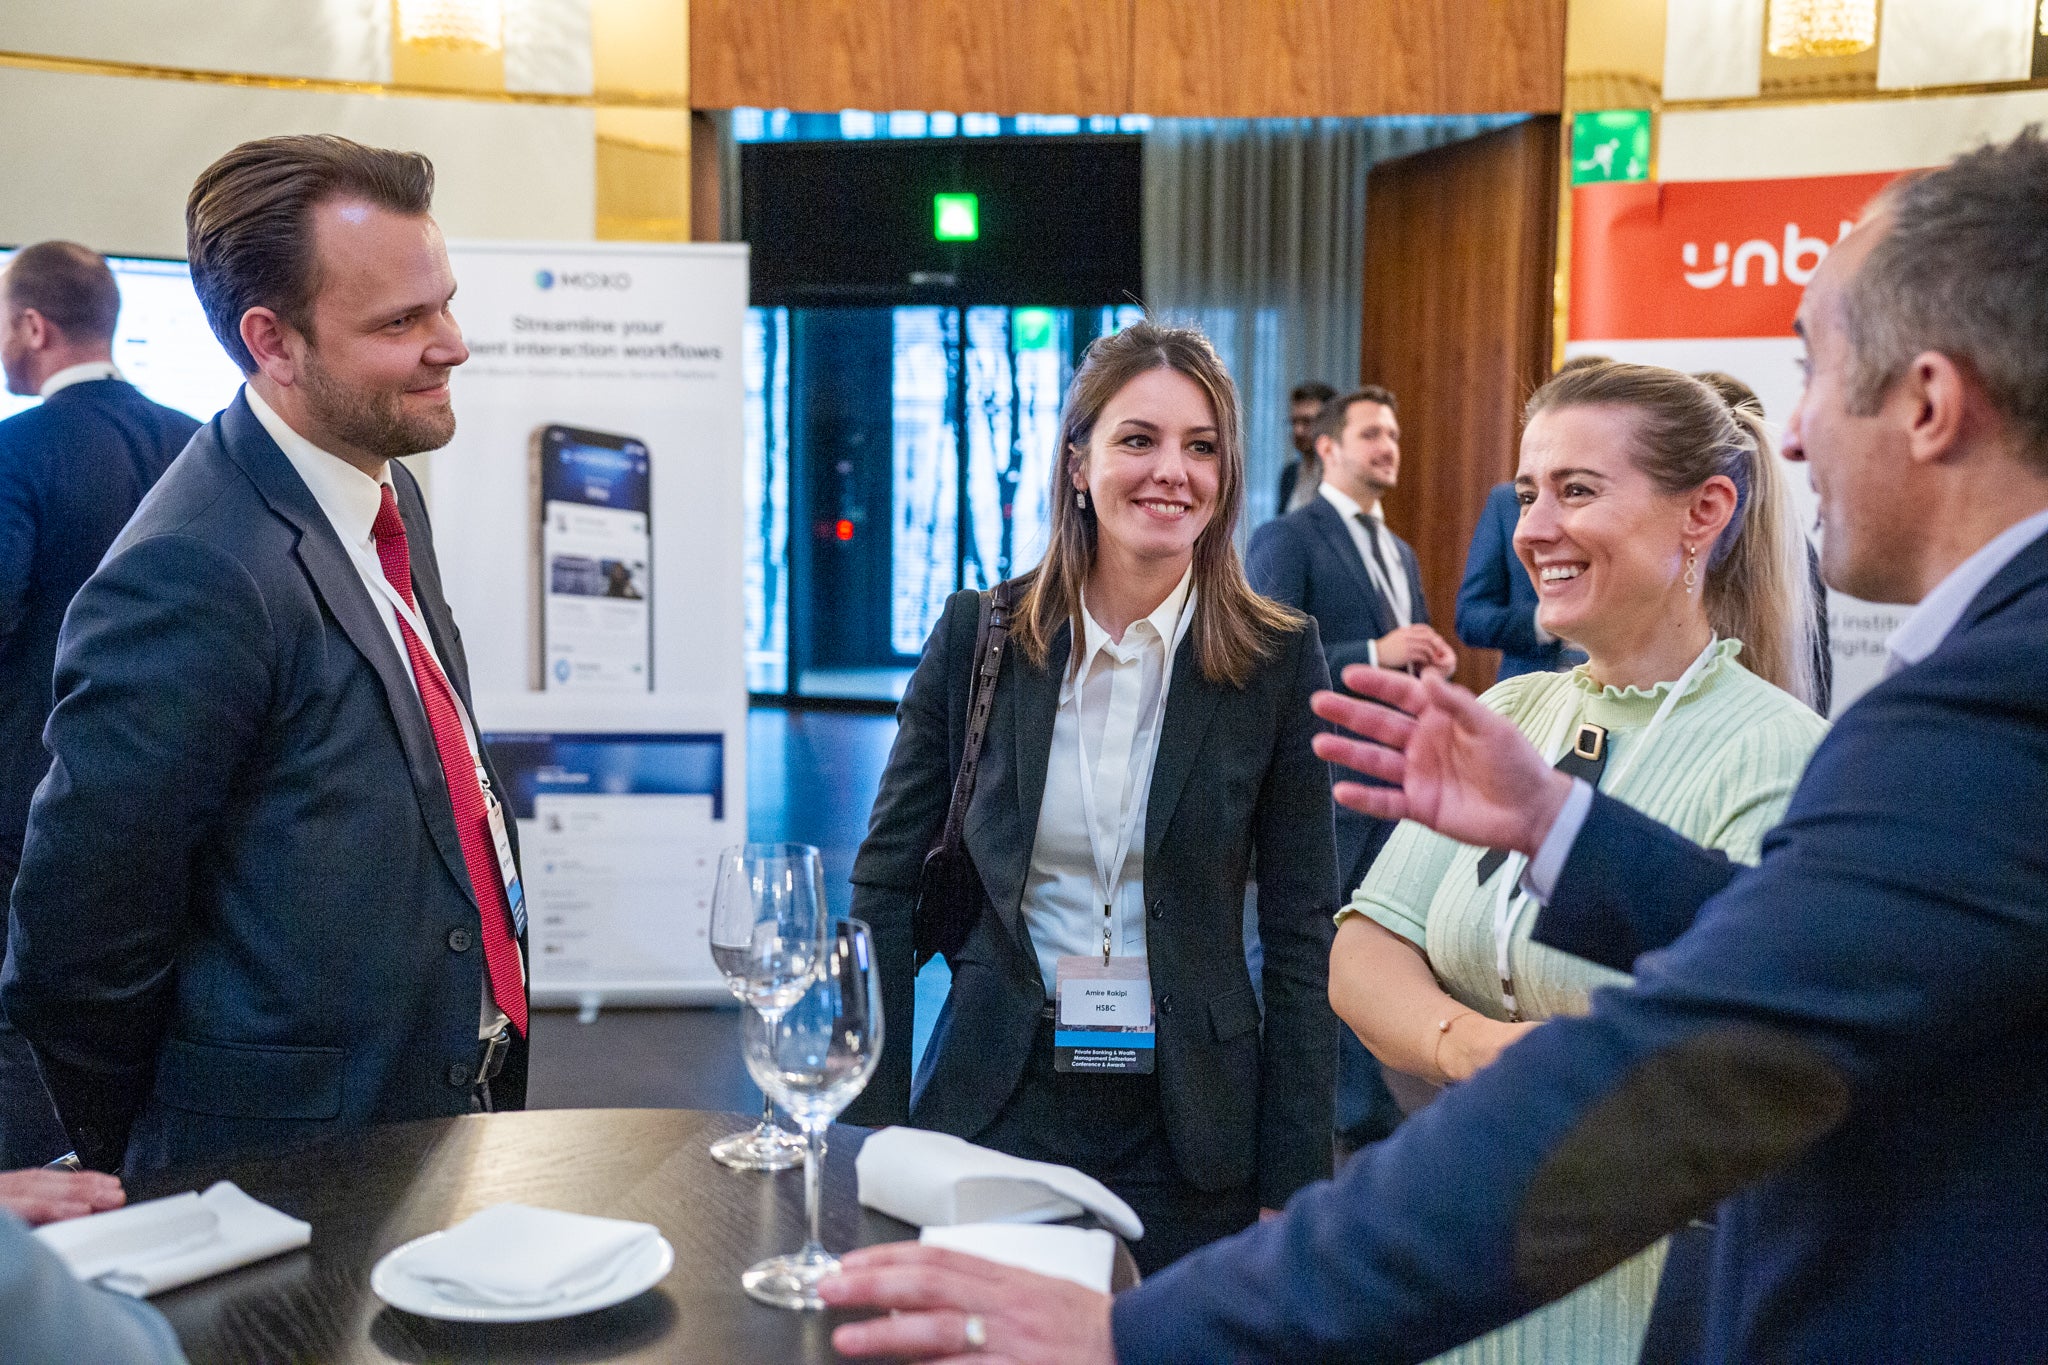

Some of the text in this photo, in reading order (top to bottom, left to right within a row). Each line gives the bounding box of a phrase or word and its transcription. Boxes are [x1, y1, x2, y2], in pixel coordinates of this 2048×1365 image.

[1682, 221, 1853, 289] unb
[513, 315, 664, 338] Streamline your
[513, 341, 617, 358] interaction
[622, 342, 722, 360] workflows
